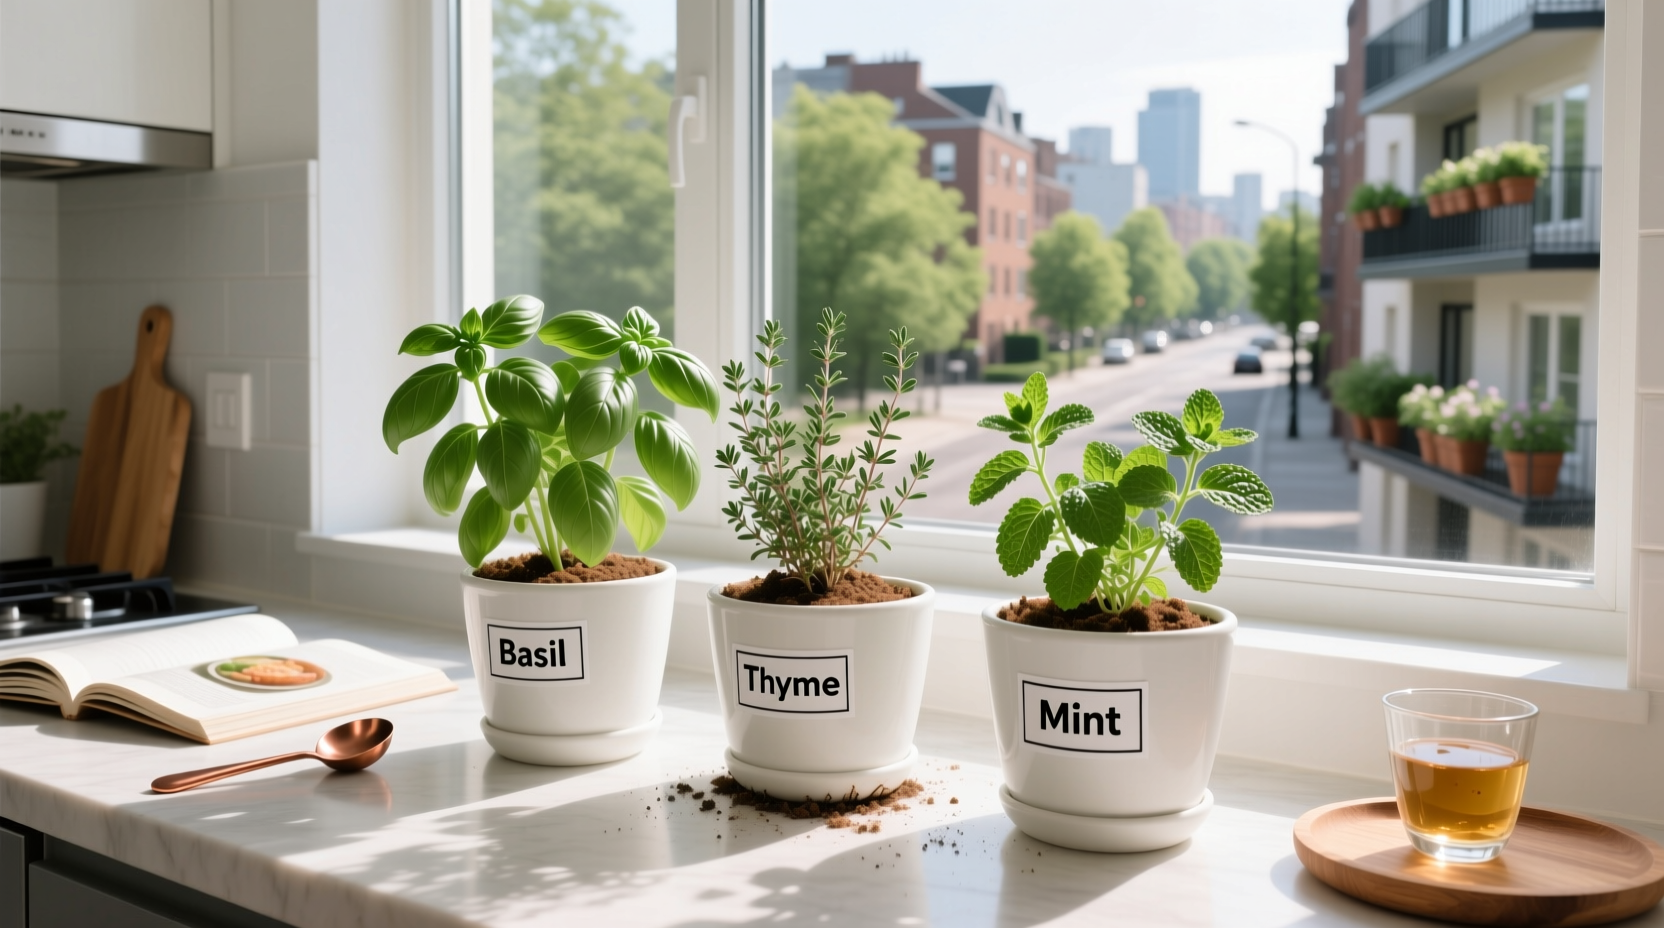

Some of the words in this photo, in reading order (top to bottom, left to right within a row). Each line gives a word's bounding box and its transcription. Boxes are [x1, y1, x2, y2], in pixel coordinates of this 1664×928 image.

[499, 638, 567, 668] Basil
[743, 664, 841, 702] Thyme
[1040, 699, 1122, 736] Mint
